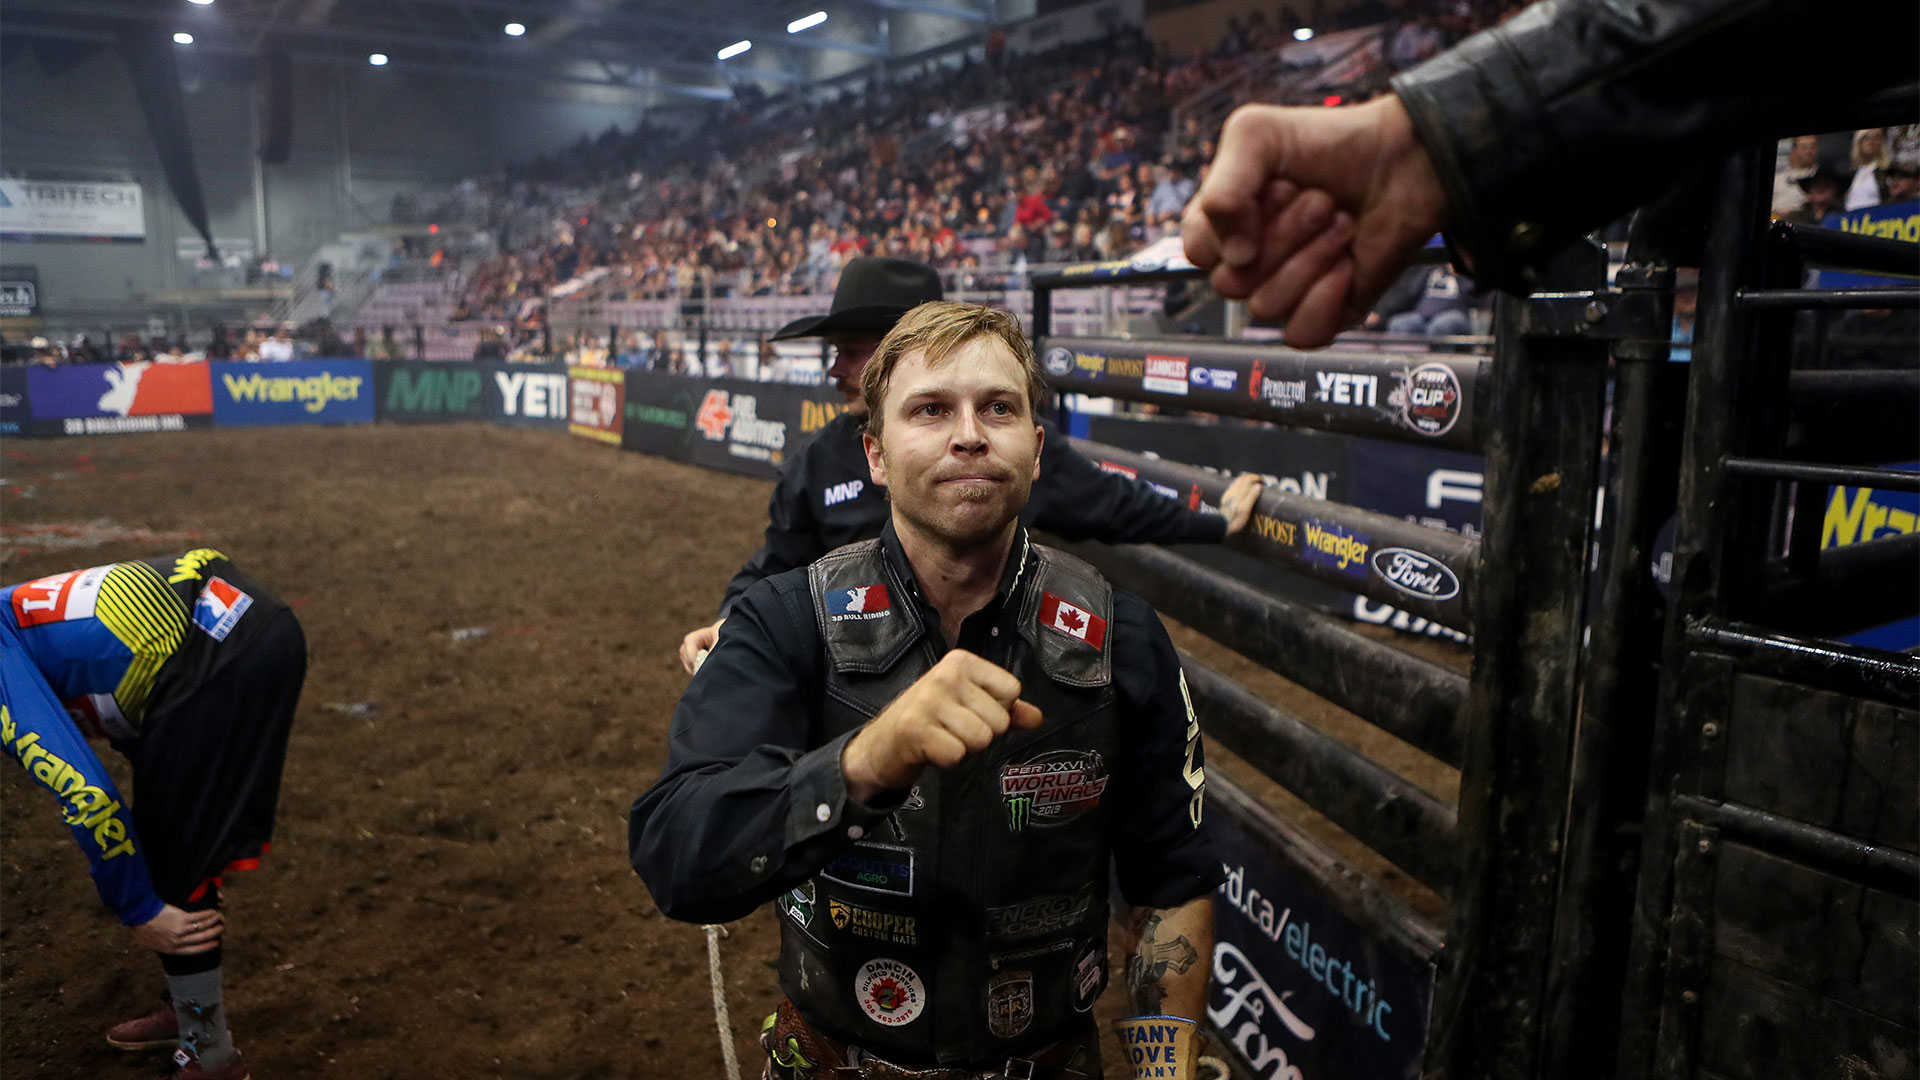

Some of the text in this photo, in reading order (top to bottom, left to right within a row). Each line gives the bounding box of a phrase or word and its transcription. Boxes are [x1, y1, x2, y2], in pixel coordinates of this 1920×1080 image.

[223, 371, 363, 413] Wrangler
[388, 368, 482, 411] MNP
[495, 370, 567, 419] YETI
[1262, 376, 1306, 402] PENDLETON
[1316, 371, 1379, 408] YETI
[1411, 387, 1444, 406] CUP
[801, 400, 850, 432] DAN
[824, 480, 864, 506] MNP
[1304, 522, 1369, 569] Wrangler
[1386, 552, 1442, 594] Ford
[843, 613, 863, 621] BULL
[1005, 773, 1082, 791] WORLD
[1035, 779, 1106, 803] FINALS
[856, 872, 889, 885] AGRO
[852, 907, 917, 936] COOPER
[863, 971, 888, 992] OILFIELD
[866, 961, 916, 982] DANCIN
[1130, 1045, 1177, 1065] OVE
[1135, 1066, 1177, 1079] PANY
